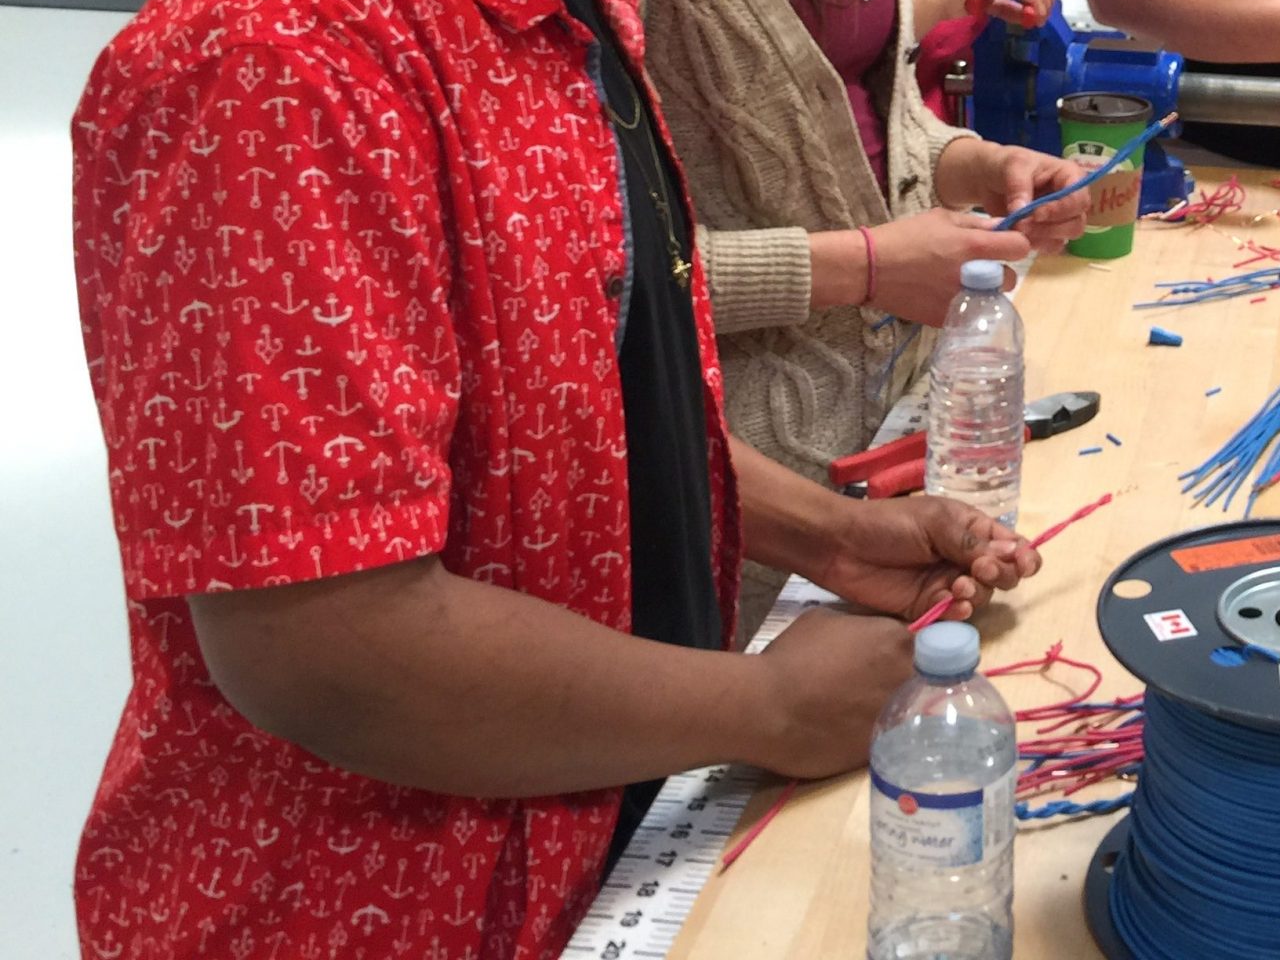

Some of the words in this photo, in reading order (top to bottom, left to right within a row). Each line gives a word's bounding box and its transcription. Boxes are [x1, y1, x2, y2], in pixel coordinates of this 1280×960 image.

[655, 850, 678, 867] 17
[636, 881, 660, 897] 18
[620, 910, 643, 927] 19
